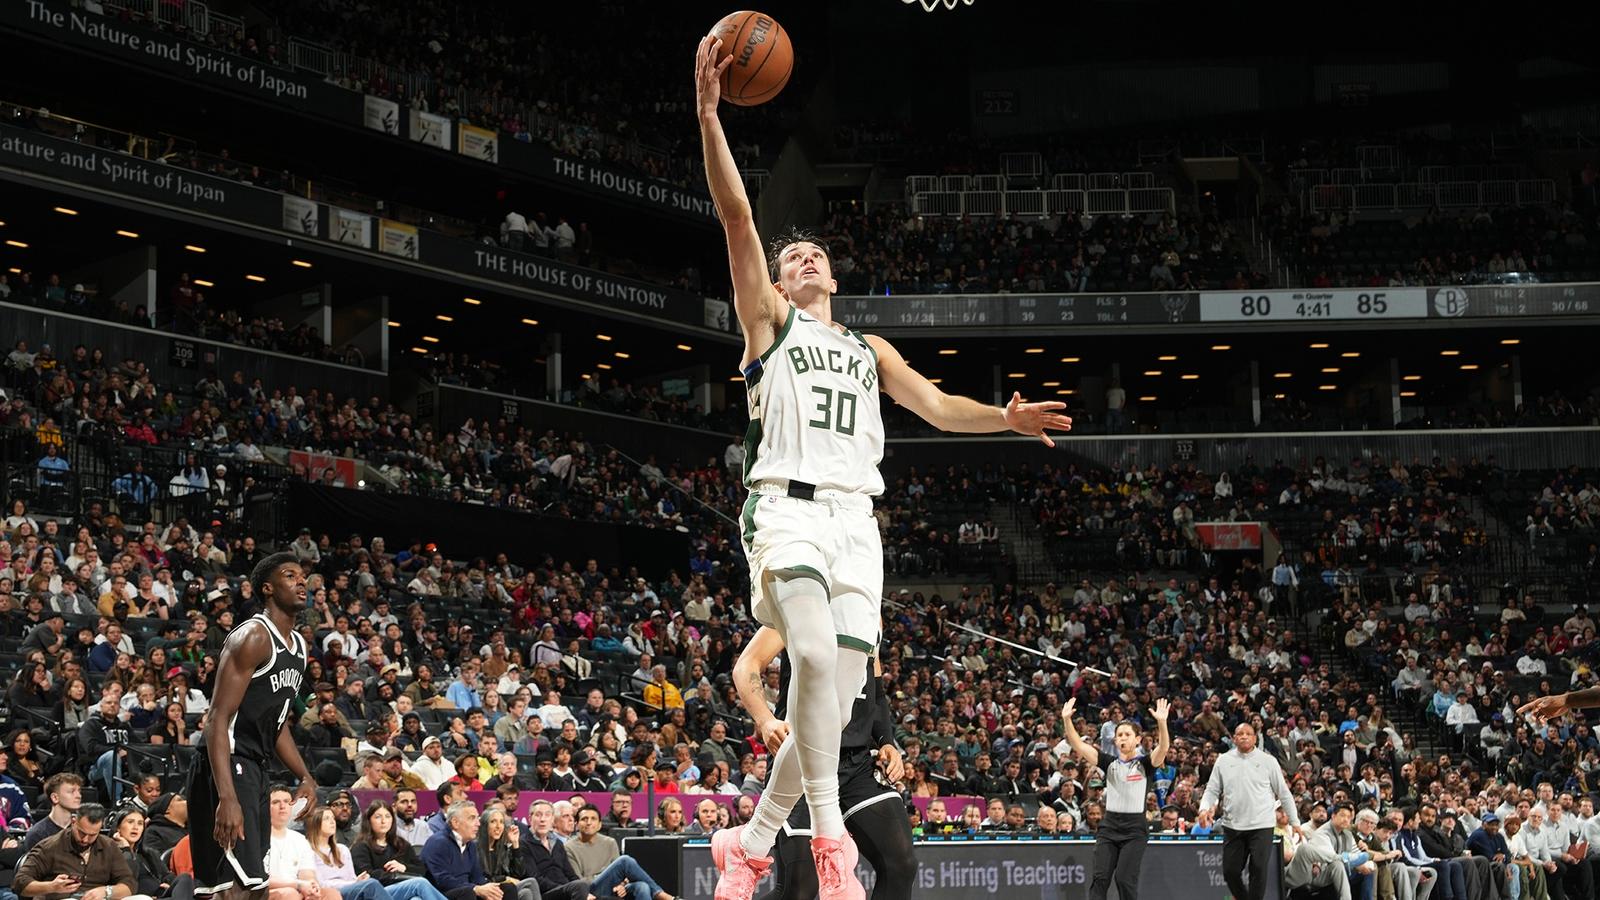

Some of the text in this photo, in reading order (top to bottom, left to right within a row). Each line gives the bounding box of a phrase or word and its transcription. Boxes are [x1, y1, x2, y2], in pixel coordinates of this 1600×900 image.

[26, 0, 307, 99] The Nature and Spirit of Japan
[736, 16, 773, 68] Wilson
[60, 152, 96, 172] and
[101, 157, 150, 184] Spirit
[153, 172, 173, 190] of
[176, 175, 225, 203] Japan
[553, 157, 585, 181] THE
[590, 168, 644, 198] HOUSE
[648, 184, 668, 204] OF
[474, 250, 667, 310] THE HOUSE OF SUNTORY
[1058, 297, 1075, 307] AST
[1120, 296, 1128, 306] 3
[1357, 293, 1388, 314] 85
[1518, 288, 1526, 298] 2
[1022, 312, 1035, 321] 39
[1061, 311, 1074, 321] 23
[1120, 311, 1128, 321] 4
[1241, 296, 1271, 317] 80
[1296, 302, 1331, 317] 4:41
[1518, 303, 1526, 313] 2
[175, 347, 193, 359] 109
[788, 346, 876, 393] BUCKS
[809, 385, 857, 437] 30
[277, 698, 290, 731] 4
[104, 729, 128, 745] NETS
[918, 860, 1086, 893] is Hiring Teachers
